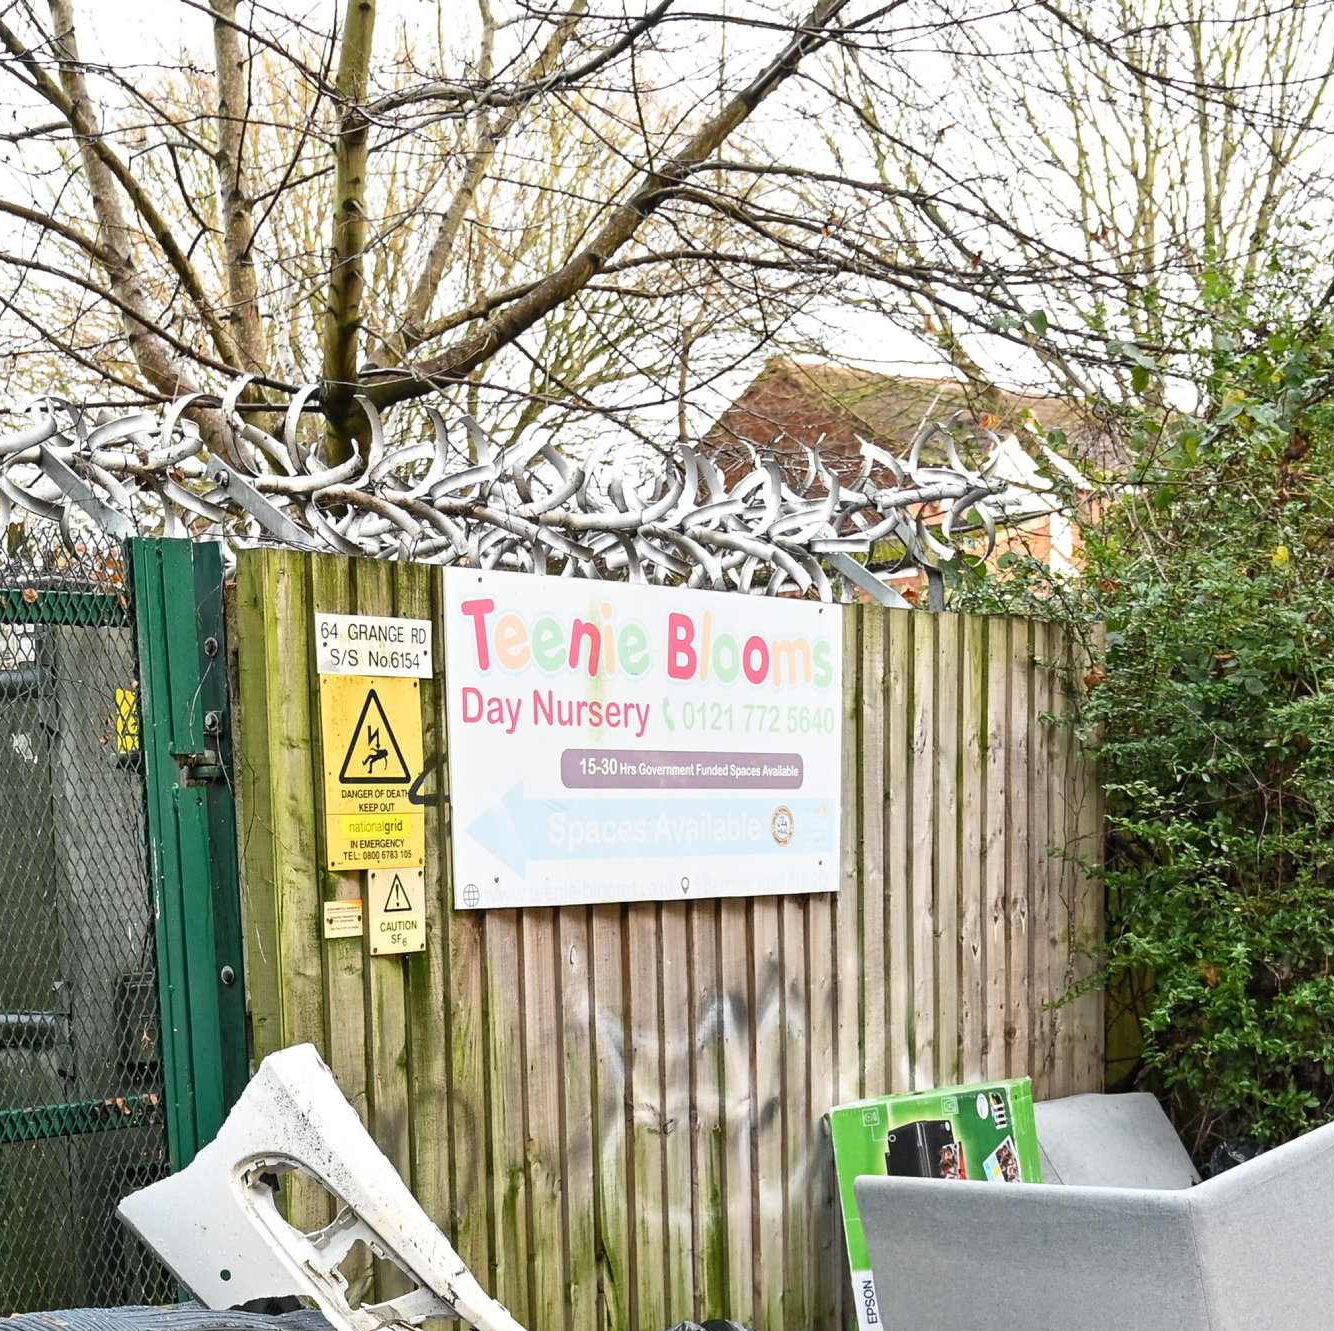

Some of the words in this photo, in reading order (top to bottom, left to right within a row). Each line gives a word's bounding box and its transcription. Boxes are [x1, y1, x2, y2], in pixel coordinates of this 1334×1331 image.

[320, 621, 339, 640] 64
[347, 623, 405, 643] GRANGE
[411, 628, 427, 645] RD
[461, 598, 651, 677] Teenie
[667, 609, 833, 689] Blooms
[330, 648, 359, 667] S/S
[462, 686, 522, 734] Day
[533, 689, 650, 738] Nursery
[682, 701, 734, 731] 0121
[743, 703, 781, 732] 772
[786, 705, 835, 734] 5640
[579, 757, 618, 775] 15-30
[619, 762, 637, 776] Hrs
[638, 762, 694, 777] Government
[695, 763, 729, 777] Funded
[729, 763, 761, 779] Spaces
[762, 764, 799, 777] Available
[341, 789, 373, 799] DANGER
[374, 789, 385, 799] OF
[358, 803, 379, 813] KEEP
[379, 802, 395, 812] OUT
[548, 811, 647, 853] Spaces
[654, 810, 761, 842] Available
[350, 840, 358, 849] IN
[359, 838, 405, 849] EMERGENCY
[362, 851, 380, 860] 0800
[381, 850, 399, 860] 6783
[400, 849, 412, 859] 105
[380, 920, 418, 932] CAUTION
[862, 1280, 878, 1325] EPSON
